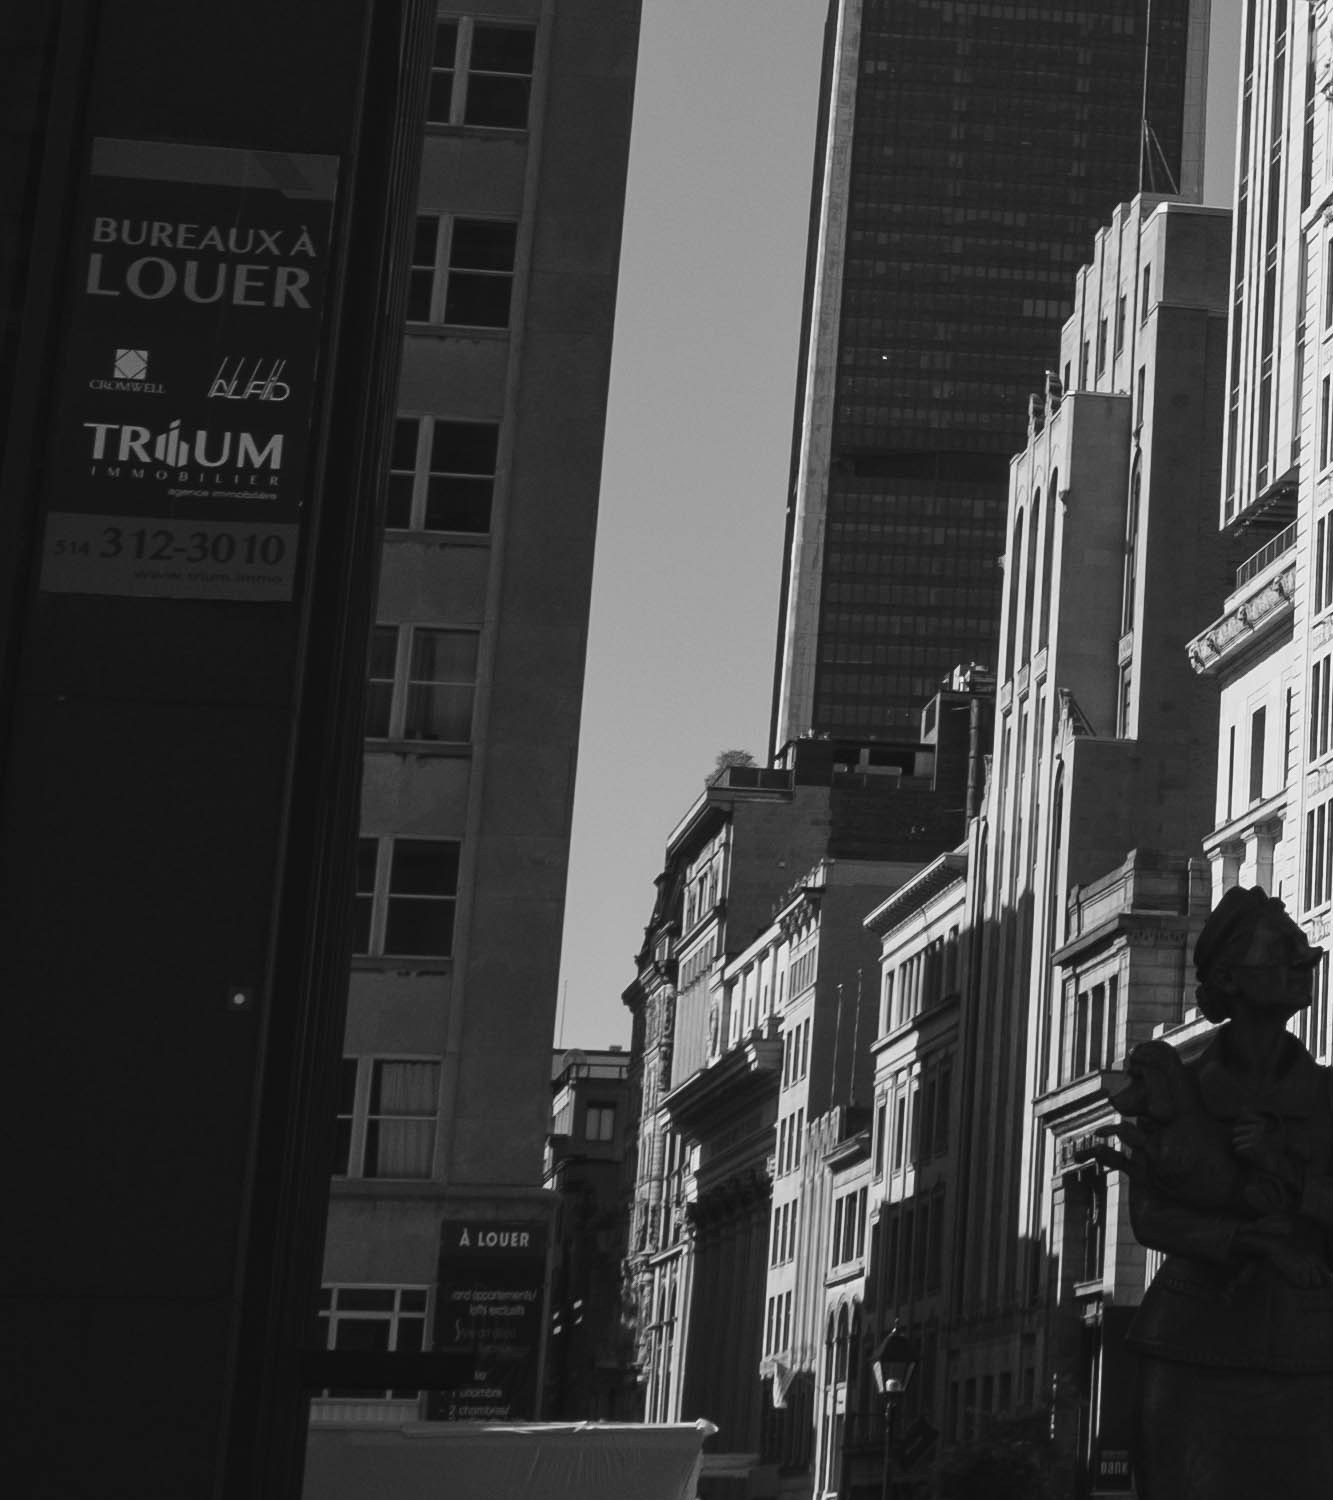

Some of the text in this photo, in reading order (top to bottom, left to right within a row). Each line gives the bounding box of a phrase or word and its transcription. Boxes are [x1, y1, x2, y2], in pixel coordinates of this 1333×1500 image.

[92, 216, 317, 257] BUREAUX À
[86, 252, 312, 309] LOUER
[88, 378, 167, 394] CROMWELL
[83, 418, 285, 470] TRIUM
[90, 465, 280, 486] IMMOBILIER
[55, 527, 286, 566] 514 312-3010
[459, 1227, 530, 1248] À LOUER
